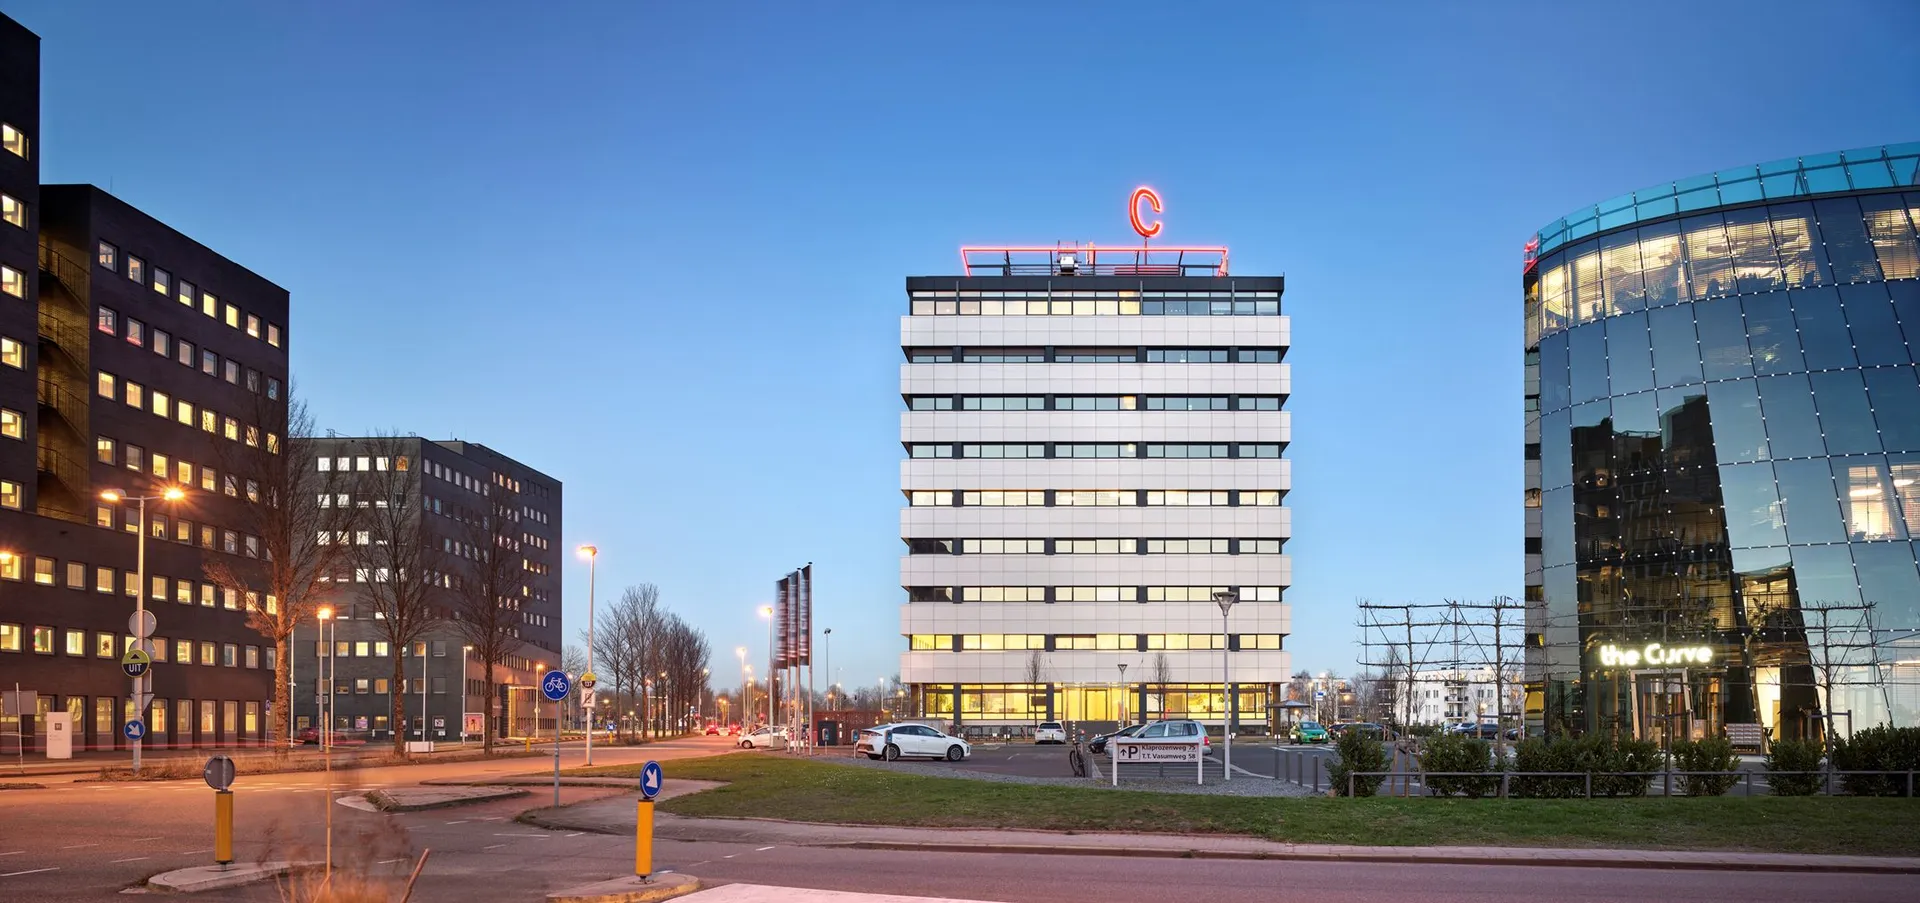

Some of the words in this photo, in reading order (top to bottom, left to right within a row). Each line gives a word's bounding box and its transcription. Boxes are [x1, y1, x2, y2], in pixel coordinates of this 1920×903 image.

[1129, 187, 1161, 238] C
[1600, 644, 1640, 666] the
[1644, 643, 1713, 665] Curve
[128, 663, 142, 673] UIT
[1128, 746, 1138, 759] P
